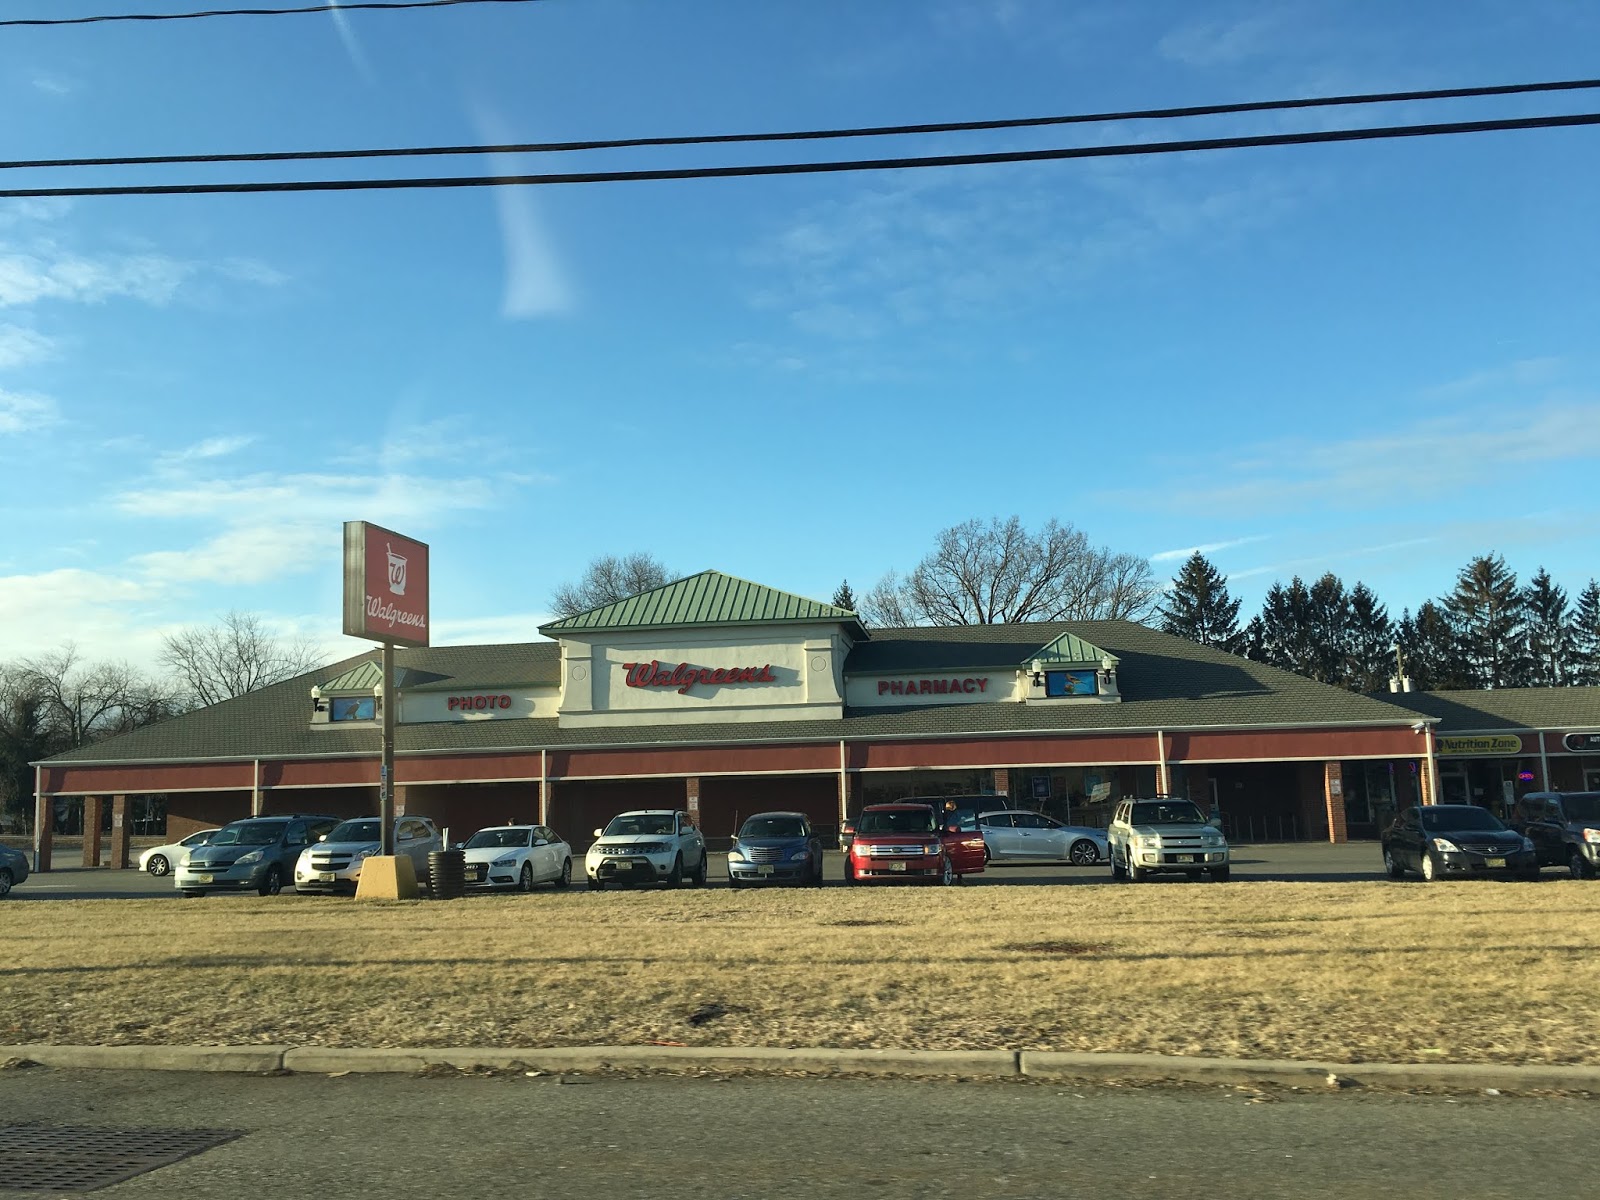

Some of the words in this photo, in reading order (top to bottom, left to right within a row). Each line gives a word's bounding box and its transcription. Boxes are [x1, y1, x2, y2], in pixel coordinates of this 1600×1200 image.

[366, 595, 426, 628] Walgreens
[622, 660, 776, 694] Walgreens
[878, 677, 988, 695] PHARMACY
[447, 694, 512, 711] PHOTO
[1444, 738, 1490, 749] Nutrition
[1491, 738, 1517, 748] Zone
